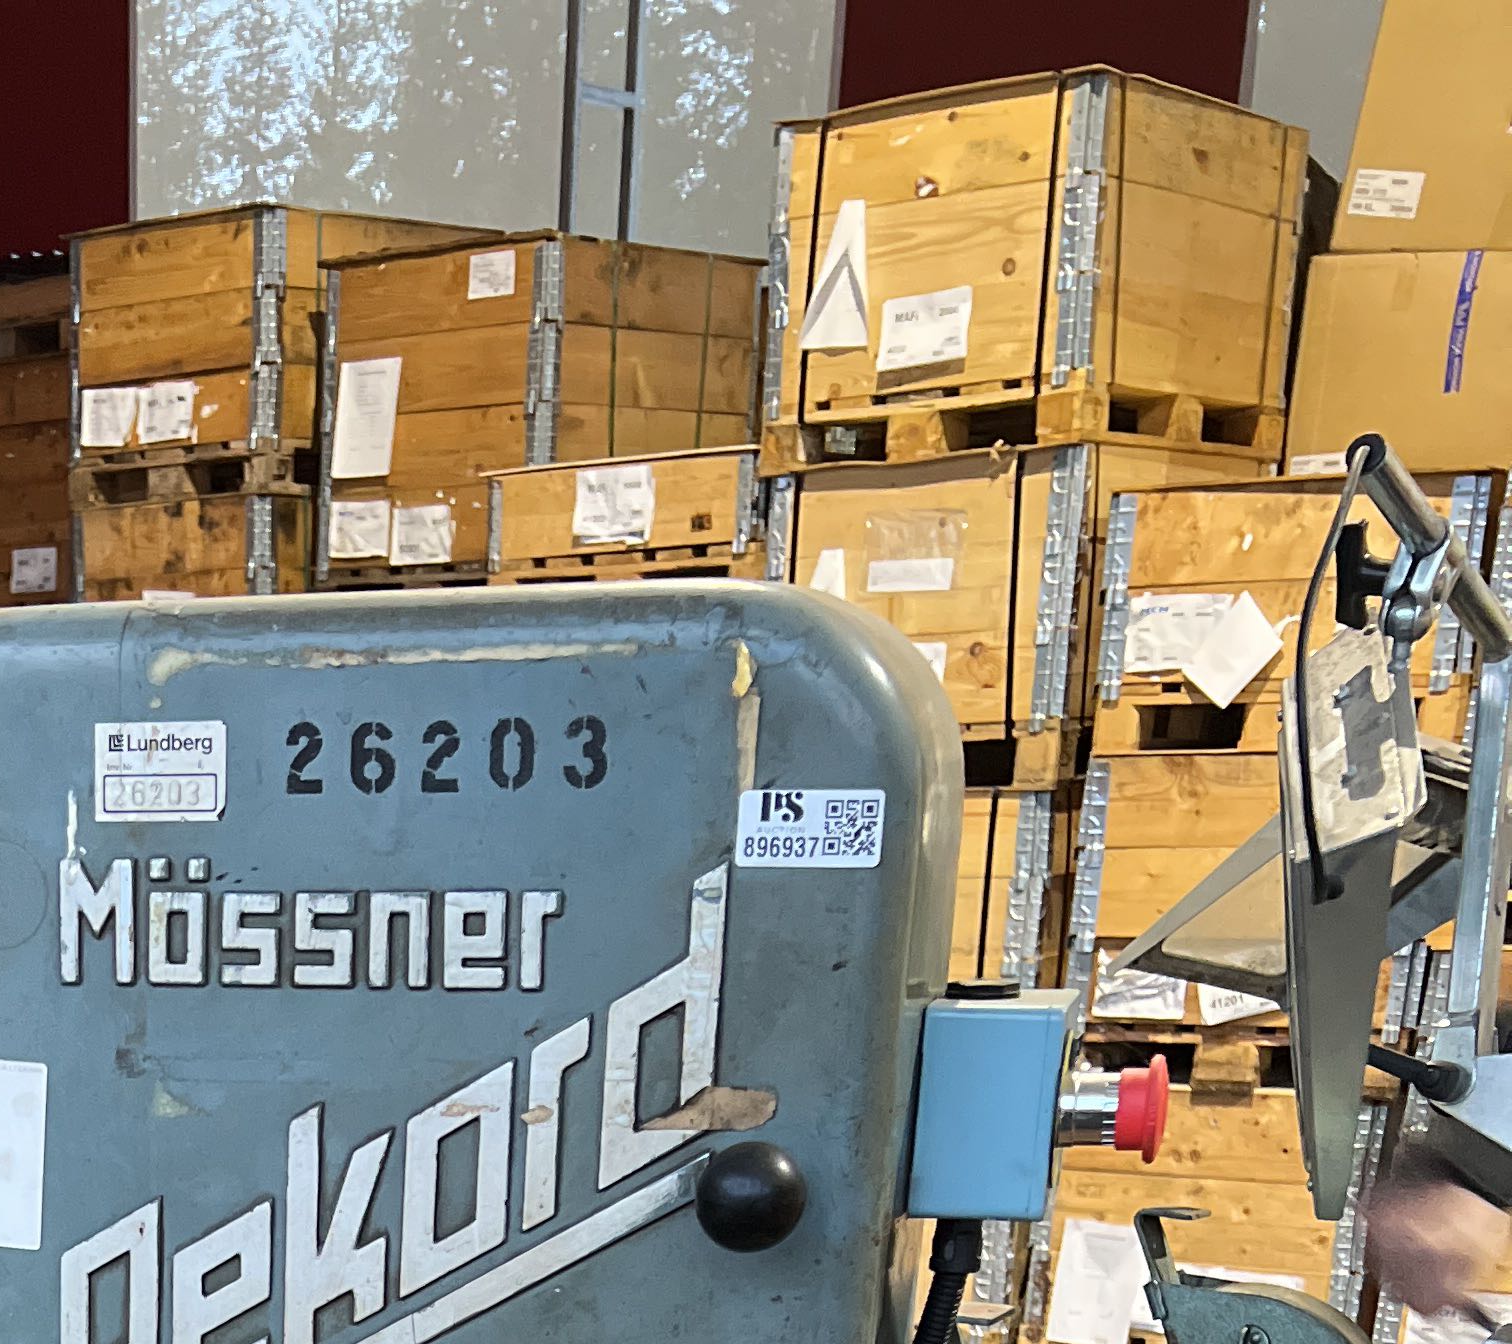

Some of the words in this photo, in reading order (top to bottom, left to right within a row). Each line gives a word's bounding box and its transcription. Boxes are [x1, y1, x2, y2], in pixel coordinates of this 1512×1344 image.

[127, 734, 213, 755] Lundberg
[286, 715, 607, 795] 26203
[112, 780, 201, 808] 26203
[756, 826, 806, 834] AUCTION
[744, 836, 820, 858] 896937
[59, 857, 564, 990] Mössner
